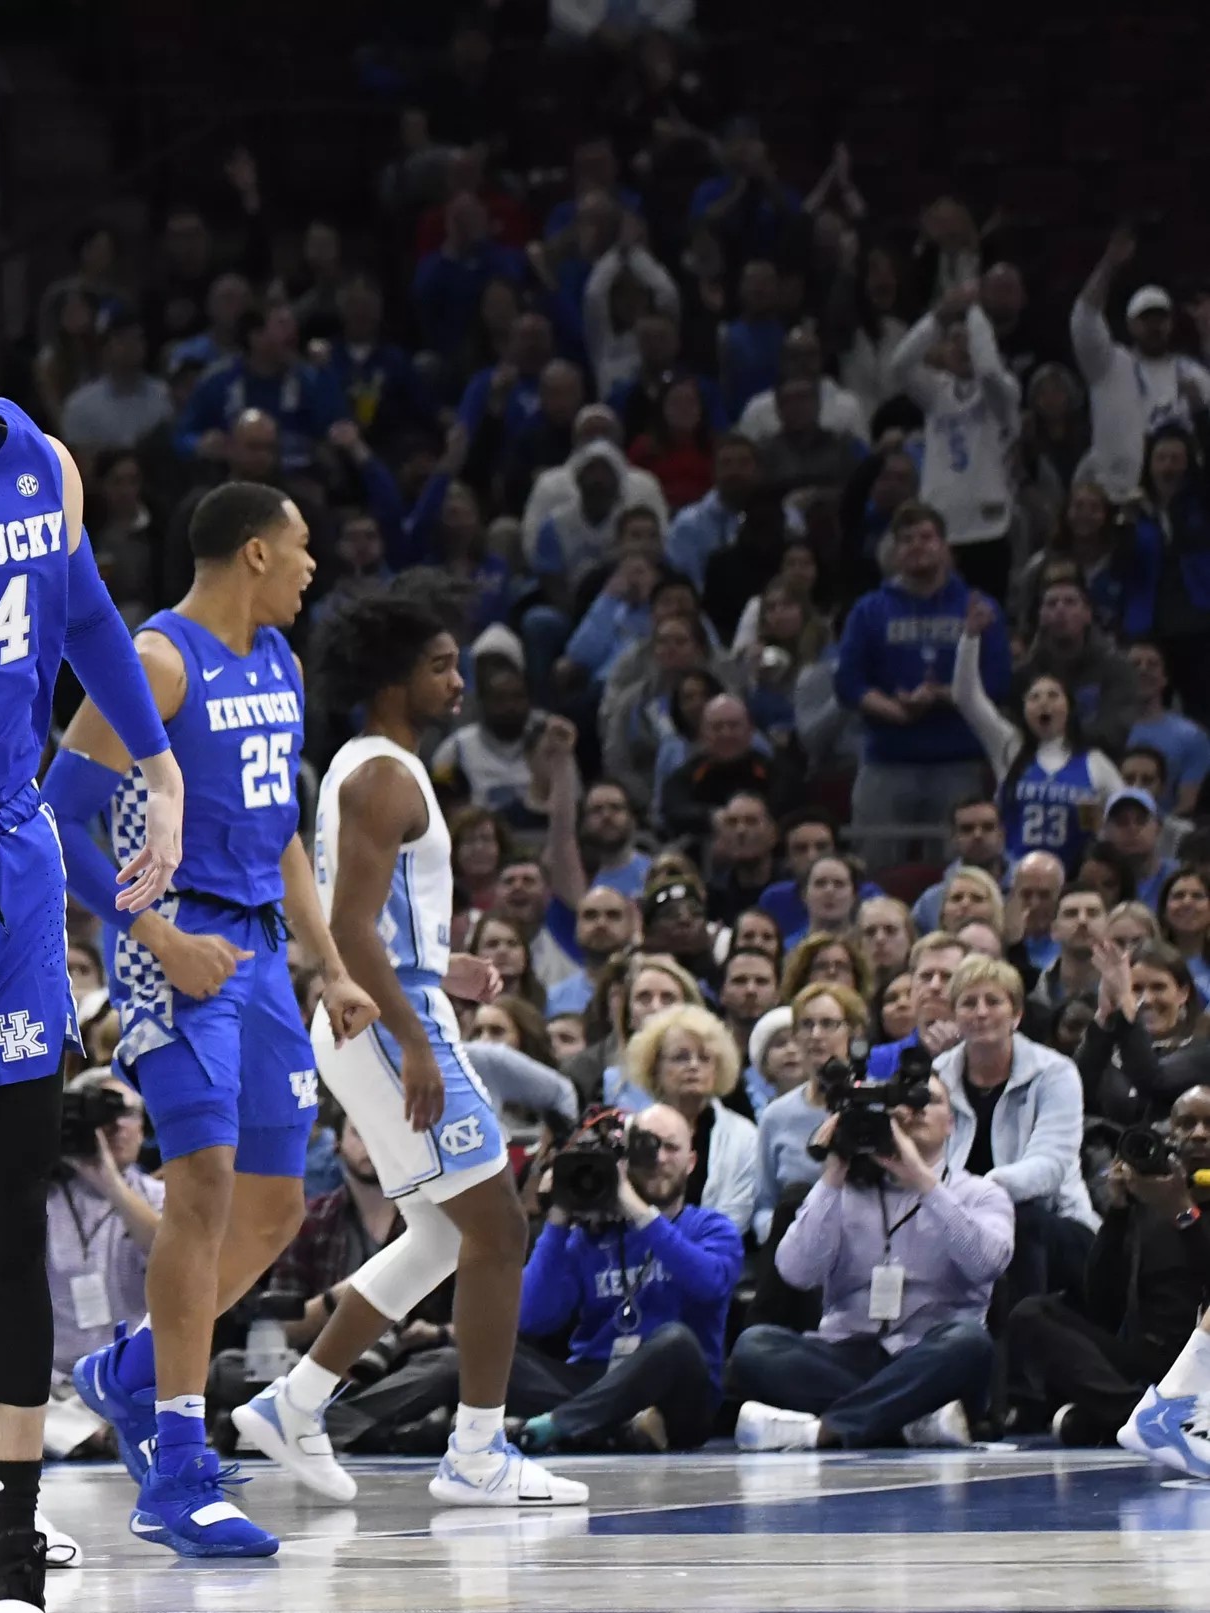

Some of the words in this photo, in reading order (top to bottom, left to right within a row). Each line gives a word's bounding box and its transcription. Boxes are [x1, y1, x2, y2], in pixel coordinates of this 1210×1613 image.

[18, 475, 38, 496] SEC
[205, 690, 300, 732] KENTUCKY
[240, 732, 293, 809] 25
[1022, 803, 1069, 847] 23
